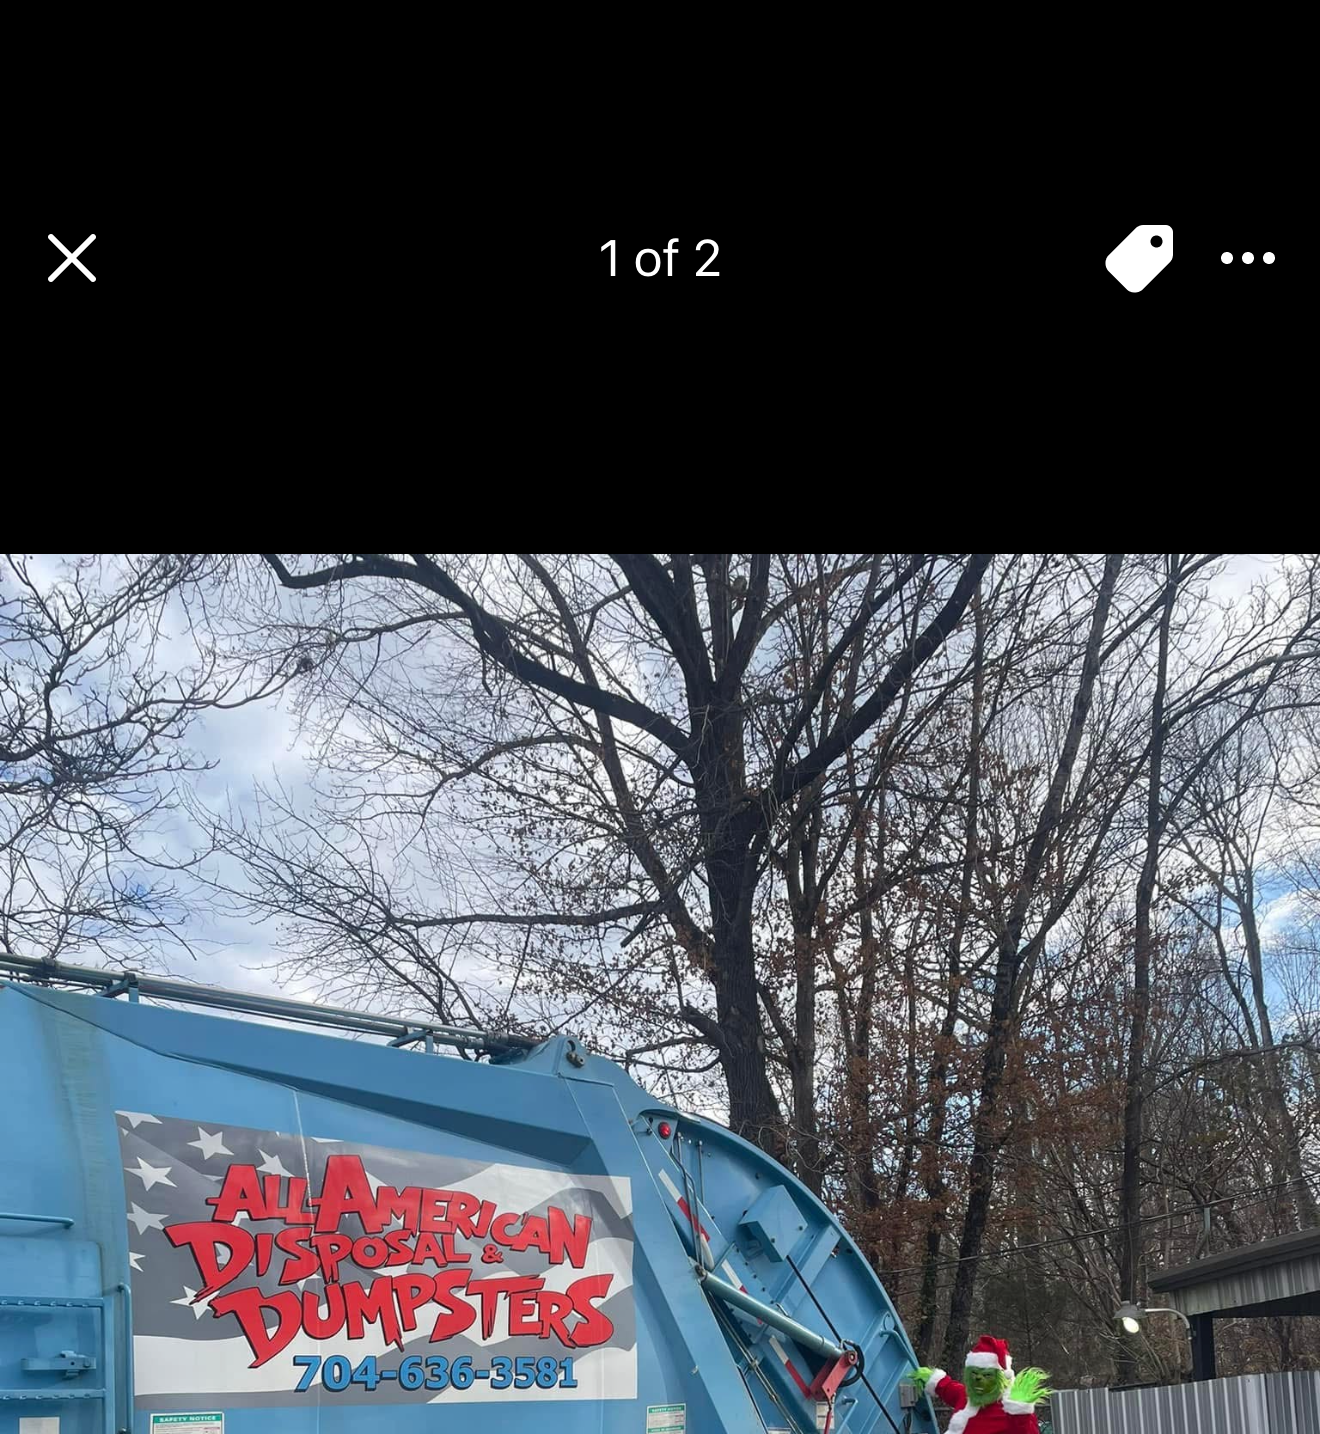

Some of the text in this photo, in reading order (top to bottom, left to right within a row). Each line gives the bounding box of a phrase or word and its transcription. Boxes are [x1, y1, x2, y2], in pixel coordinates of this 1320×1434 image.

[205, 1154, 593, 1269] ALL AMERICAN
[162, 1220, 504, 1306] DISPOSAL &
[207, 1268, 615, 1369] DUMPSTERS
[293, 1354, 579, 1393] 704-636-3581
